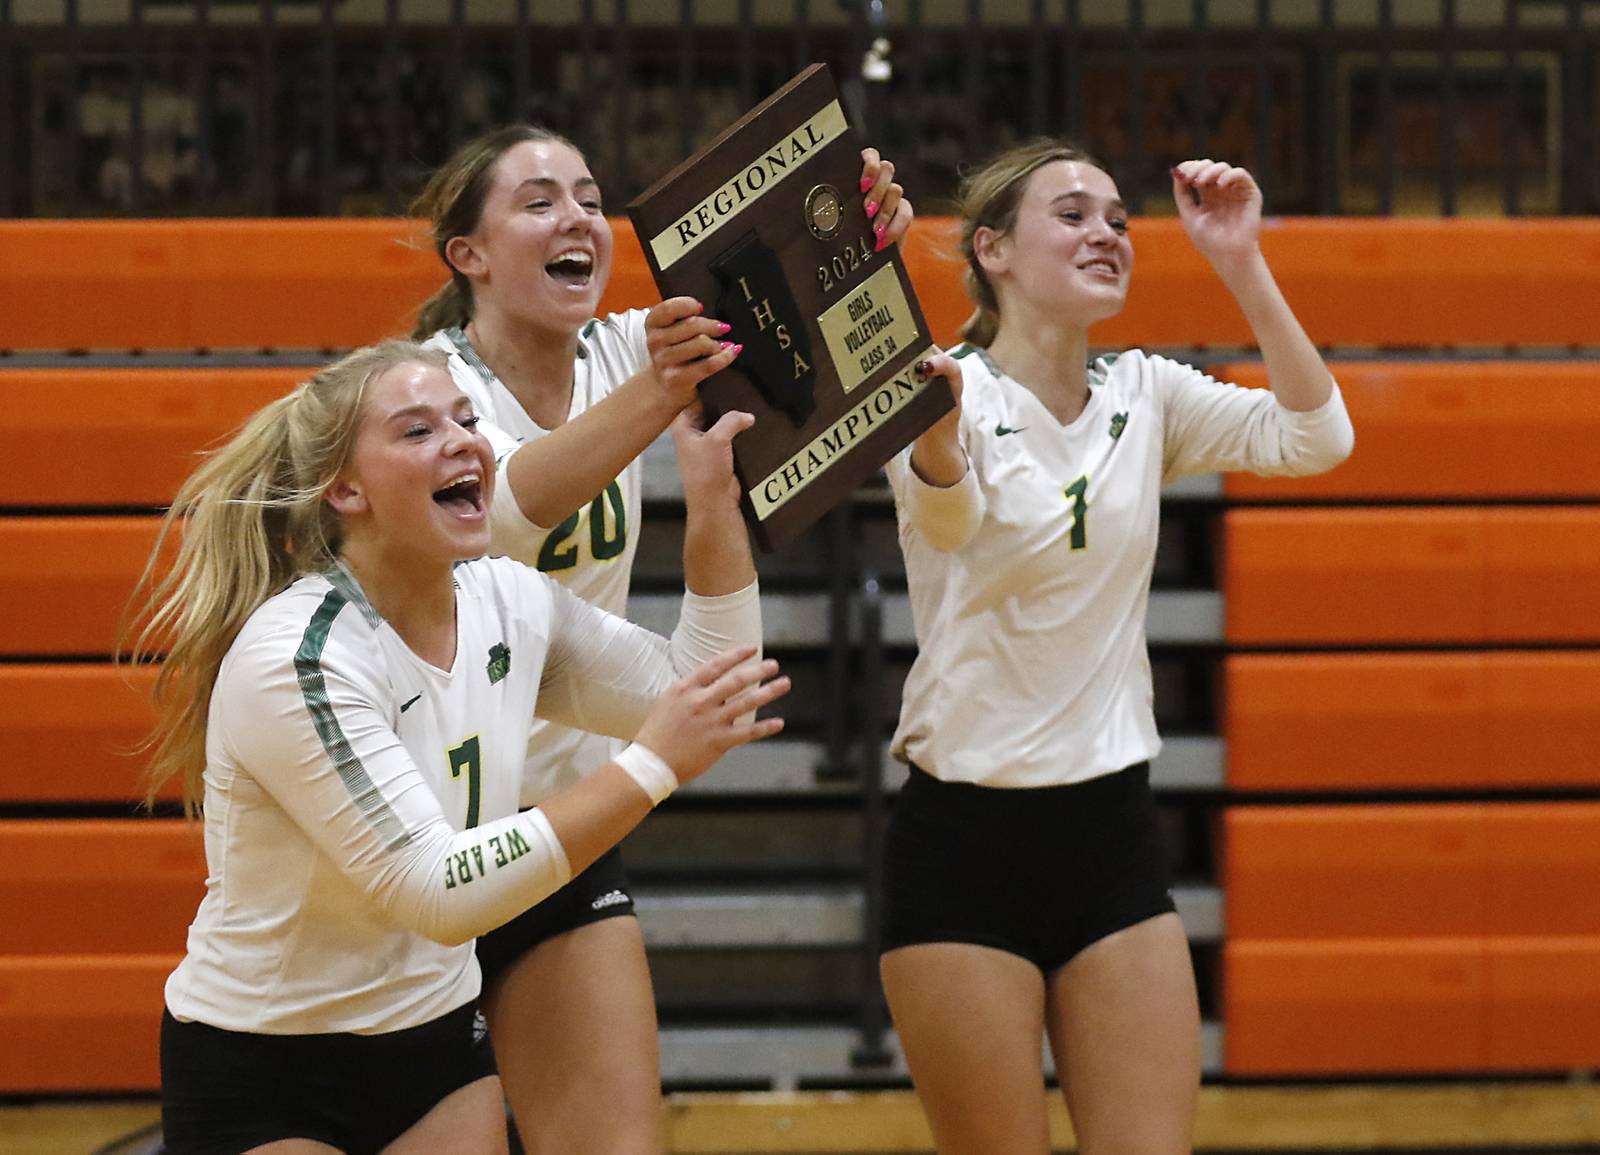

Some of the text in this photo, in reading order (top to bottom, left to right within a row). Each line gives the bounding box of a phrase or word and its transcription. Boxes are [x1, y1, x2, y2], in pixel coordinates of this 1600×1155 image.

[676, 123, 825, 246] REGIONAL
[818, 236, 873, 292] 2024
[843, 305, 895, 354] VOLLEYBALL
[848, 290, 874, 322] GIRLS
[860, 335, 898, 374] CLASS 3A
[536, 476, 628, 573] 20
[1063, 472, 1088, 551] 1
[444, 731, 482, 830] 7
[445, 827, 531, 890] WE ARE
